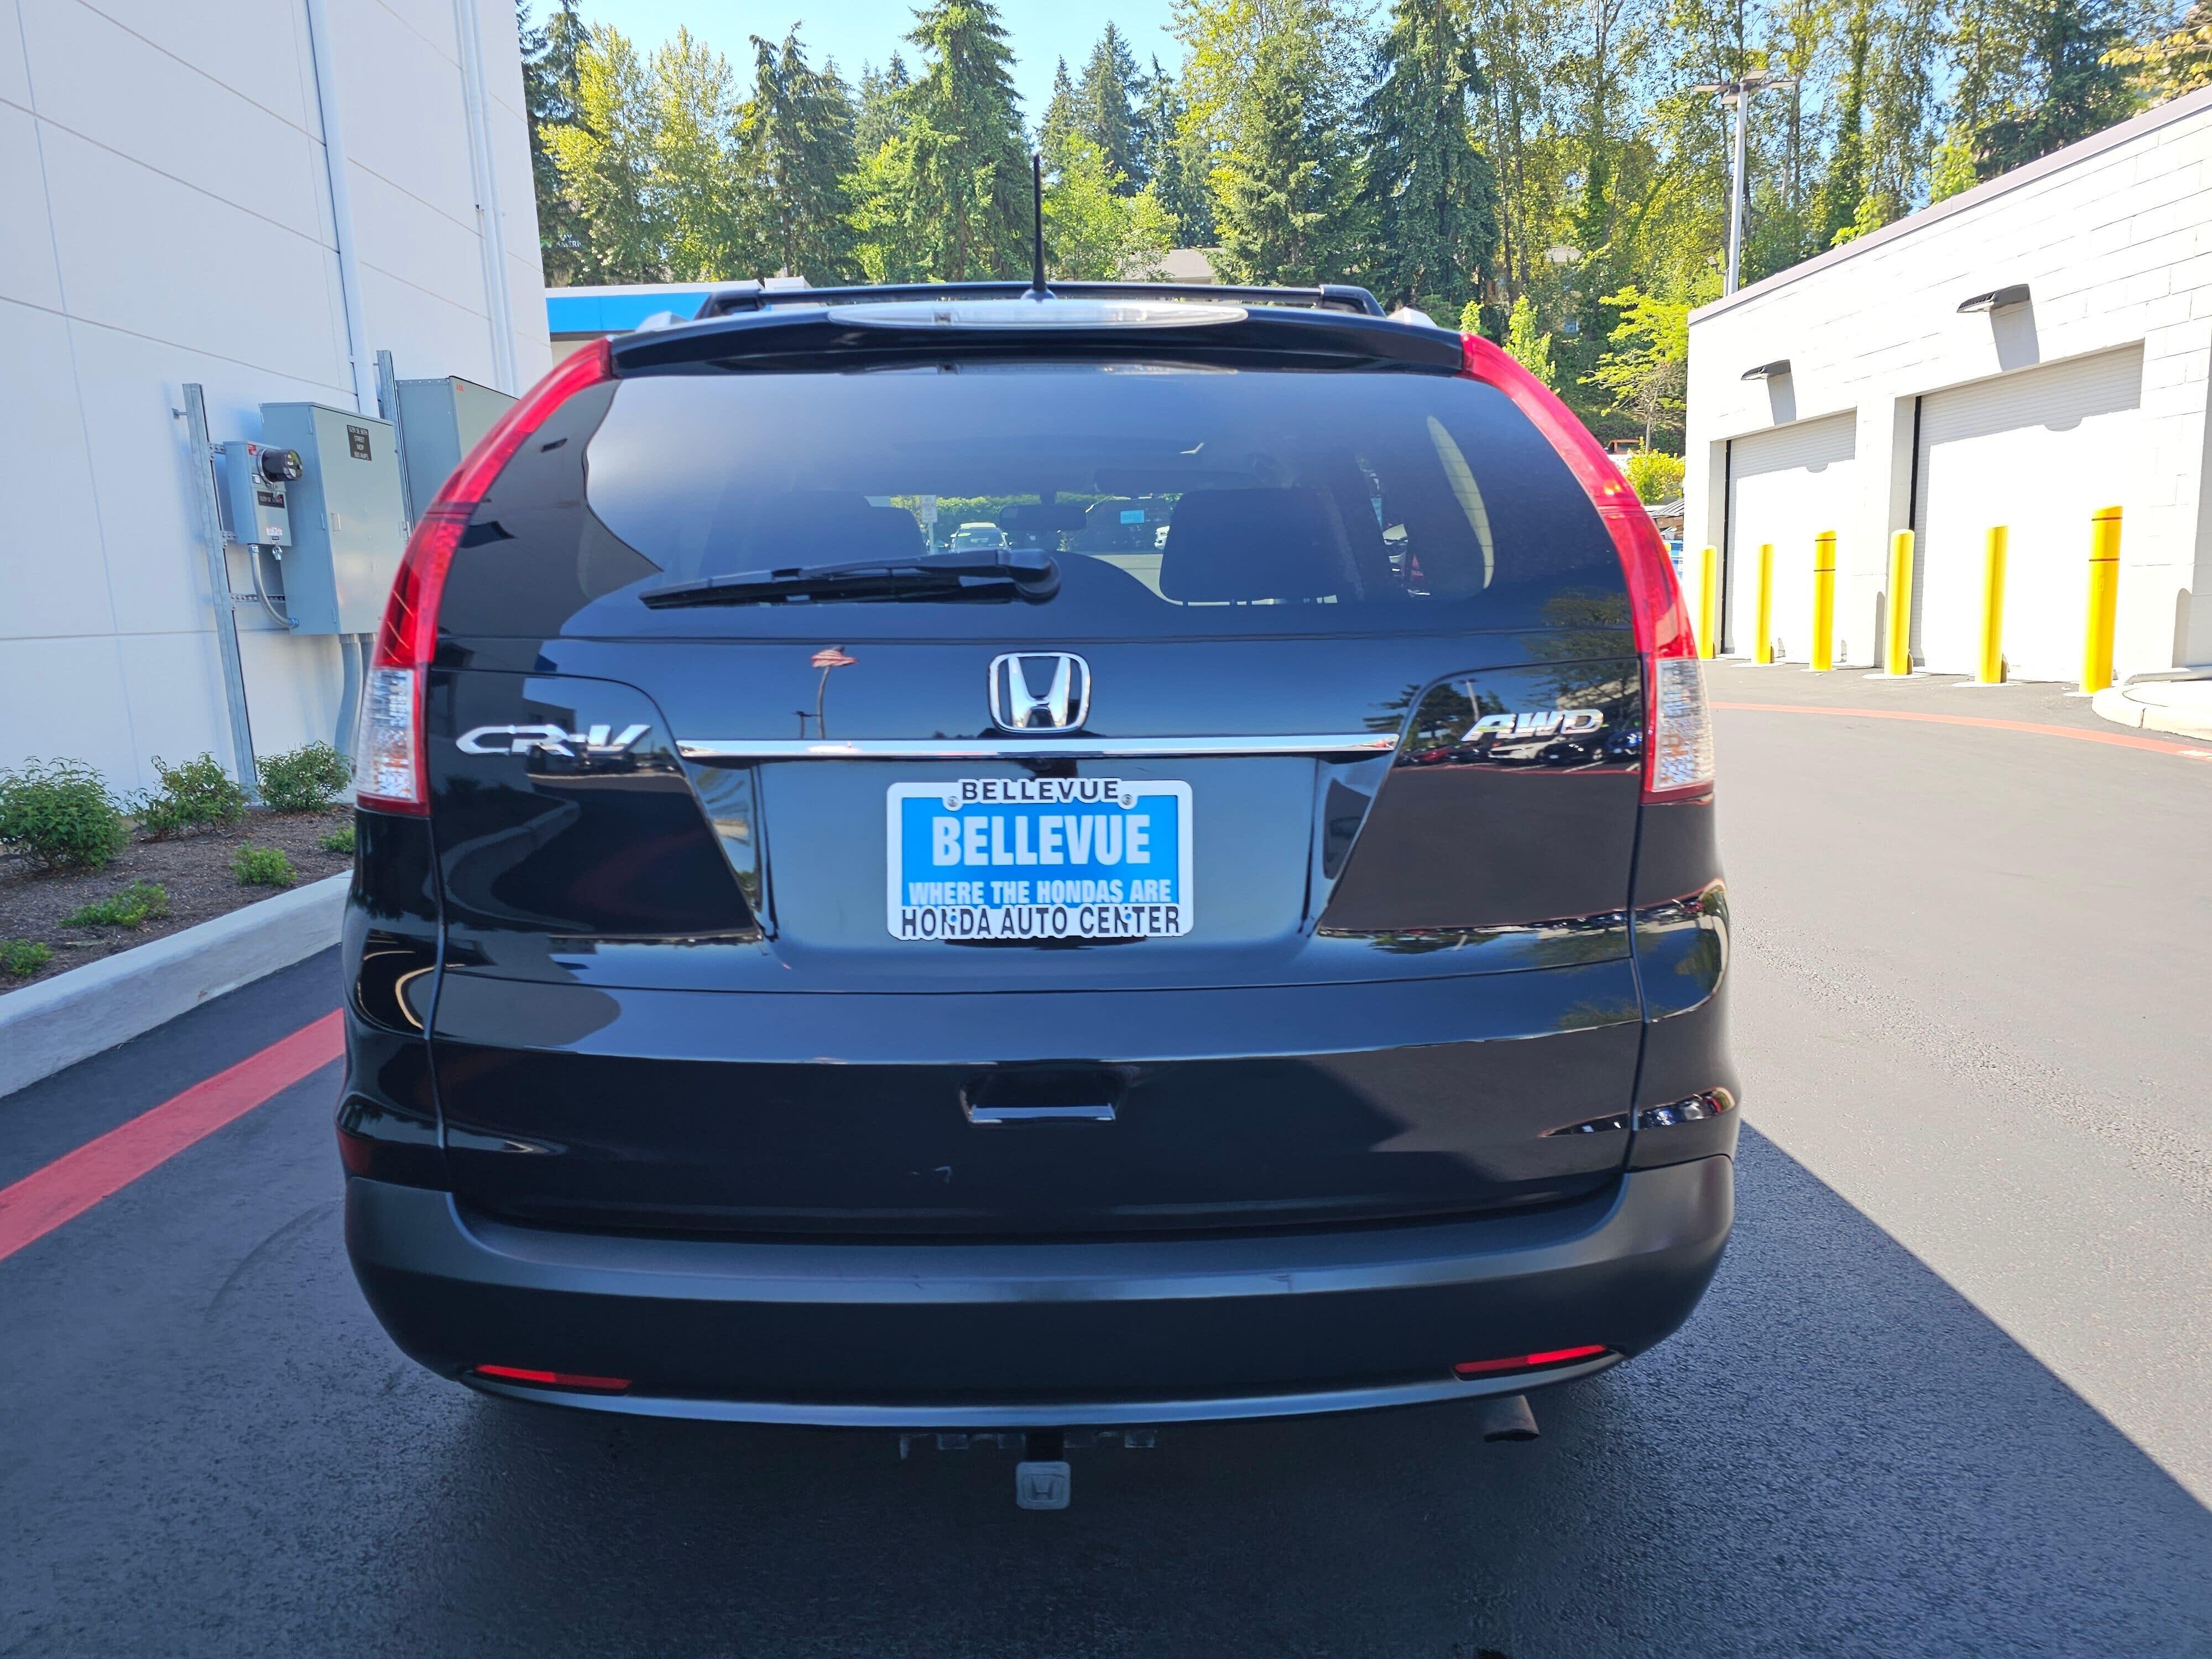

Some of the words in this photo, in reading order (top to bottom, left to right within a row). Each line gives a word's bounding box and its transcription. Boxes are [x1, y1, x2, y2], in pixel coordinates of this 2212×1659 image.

[456, 724, 651, 757] CR-V
[1460, 708, 1604, 742] AWD
[962, 781, 1118, 801] BELLEVUE
[932, 815, 1151, 866] BELLEVUE
[909, 881, 984, 905] WHERE
[990, 881, 1030, 904] THE
[1037, 880, 1124, 904] HONDAS
[1129, 879, 1172, 902] ARE
[902, 908, 992, 937] HONDA
[1000, 907, 1068, 935] AUTO
[1079, 905, 1180, 933] CENTER
